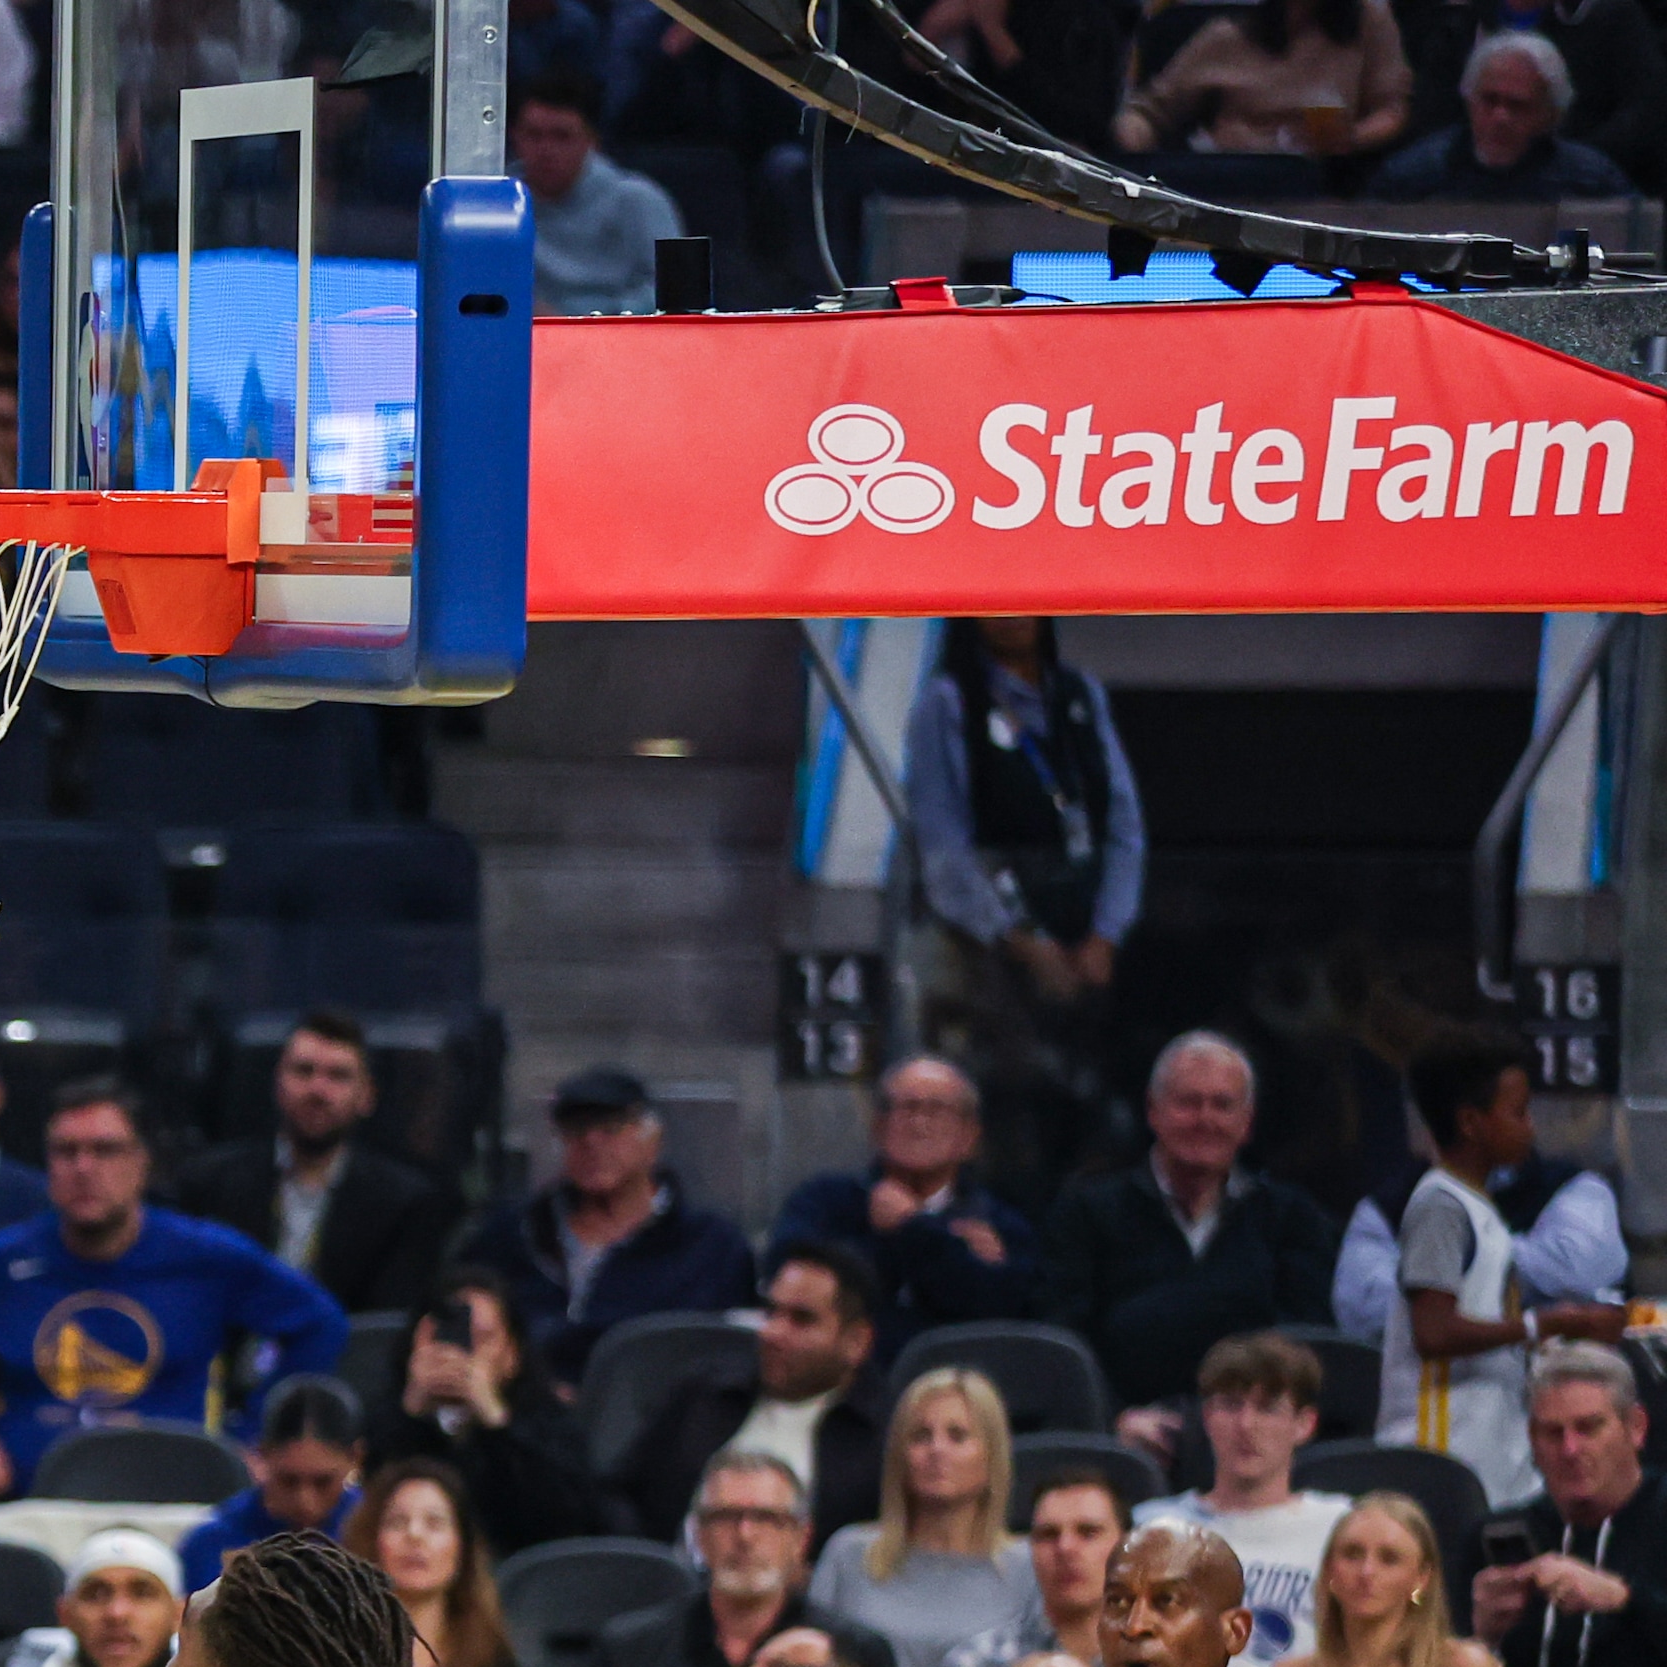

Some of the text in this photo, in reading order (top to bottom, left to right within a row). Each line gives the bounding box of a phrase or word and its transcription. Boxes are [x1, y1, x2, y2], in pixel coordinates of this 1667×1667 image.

[796, 957, 864, 1007] 14
[1535, 968, 1599, 1020] 16
[796, 1020, 862, 1075] 13
[1535, 1036, 1599, 1087] 15
